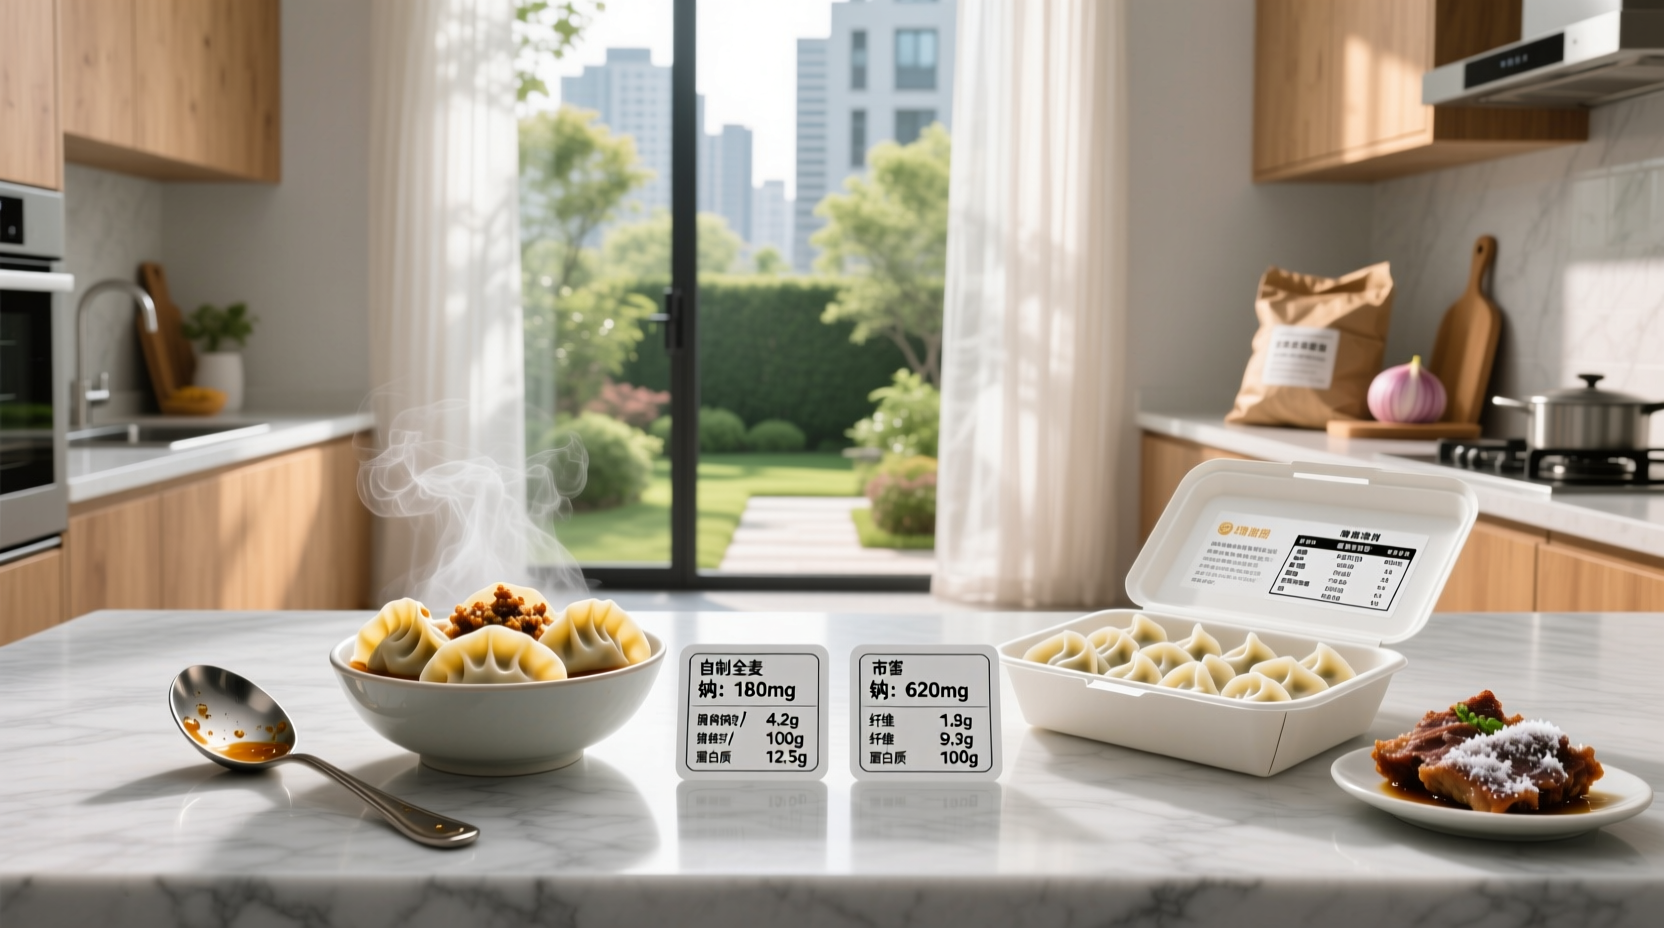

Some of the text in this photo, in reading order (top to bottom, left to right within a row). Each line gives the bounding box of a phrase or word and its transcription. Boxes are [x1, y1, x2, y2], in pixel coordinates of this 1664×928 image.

[734, 681, 796, 702] 180mg
[905, 681, 969, 702] 620mg
[766, 713, 799, 729] 4.2g
[766, 732, 804, 748] 100g
[766, 750, 807, 768] 12.5g
[940, 750, 978, 768] 100g
